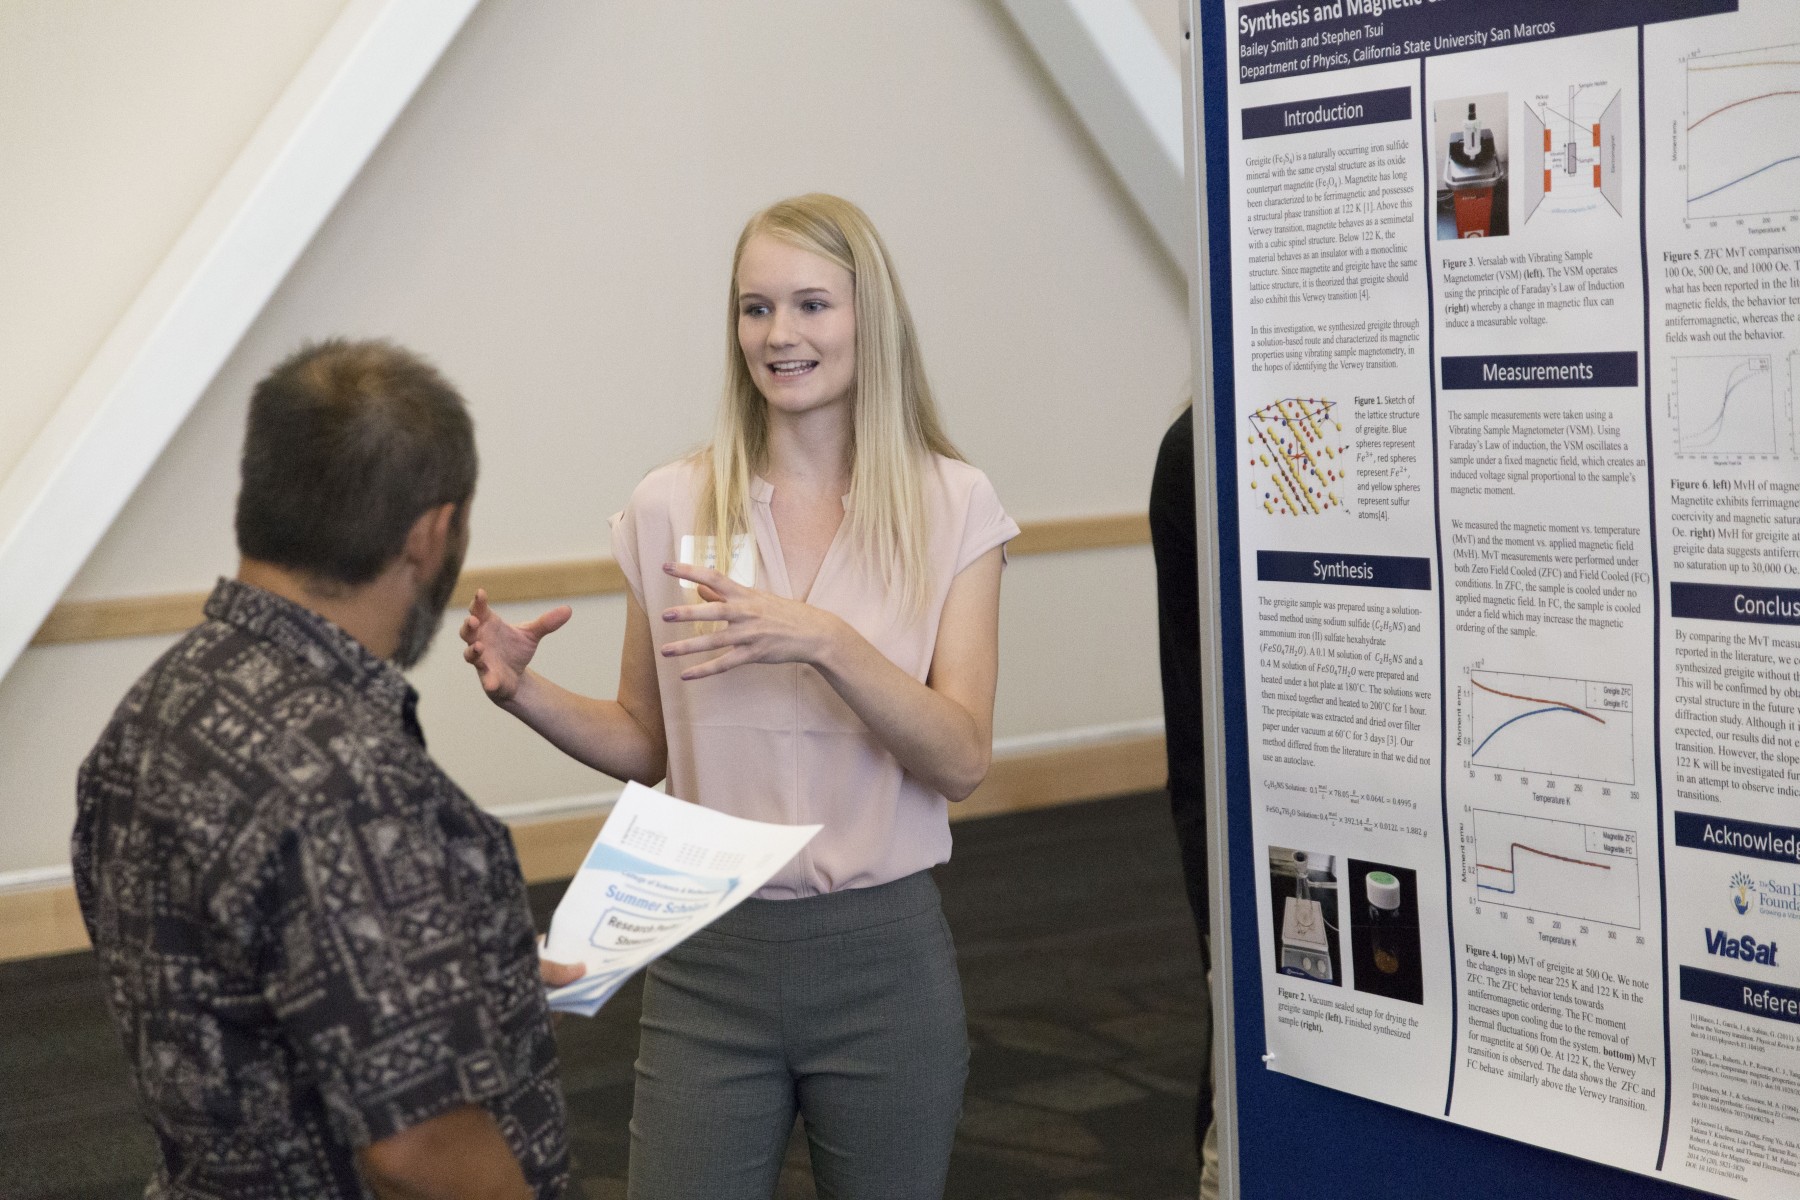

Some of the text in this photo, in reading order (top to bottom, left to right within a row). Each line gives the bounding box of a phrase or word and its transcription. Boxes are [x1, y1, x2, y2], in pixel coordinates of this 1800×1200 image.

[1239, 6, 1310, 37] Synthesis
[1313, 0, 1343, 22] and
[1240, 22, 1383, 57] Bailey Smith and Stephen Tsui
[1240, 23, 1555, 80] Department of Physics, California State University San Marcos
[1284, 102, 1364, 127] Introduction
[1483, 362, 1593, 381] Measurements
[1313, 559, 1374, 580] Synthesis
[605, 884, 662, 912] Summer
[1768, 880, 1791, 895] San
[607, 916, 654, 933] Research
[1704, 927, 1778, 967] ViaSat
[1743, 986, 1800, 1014] Refere
